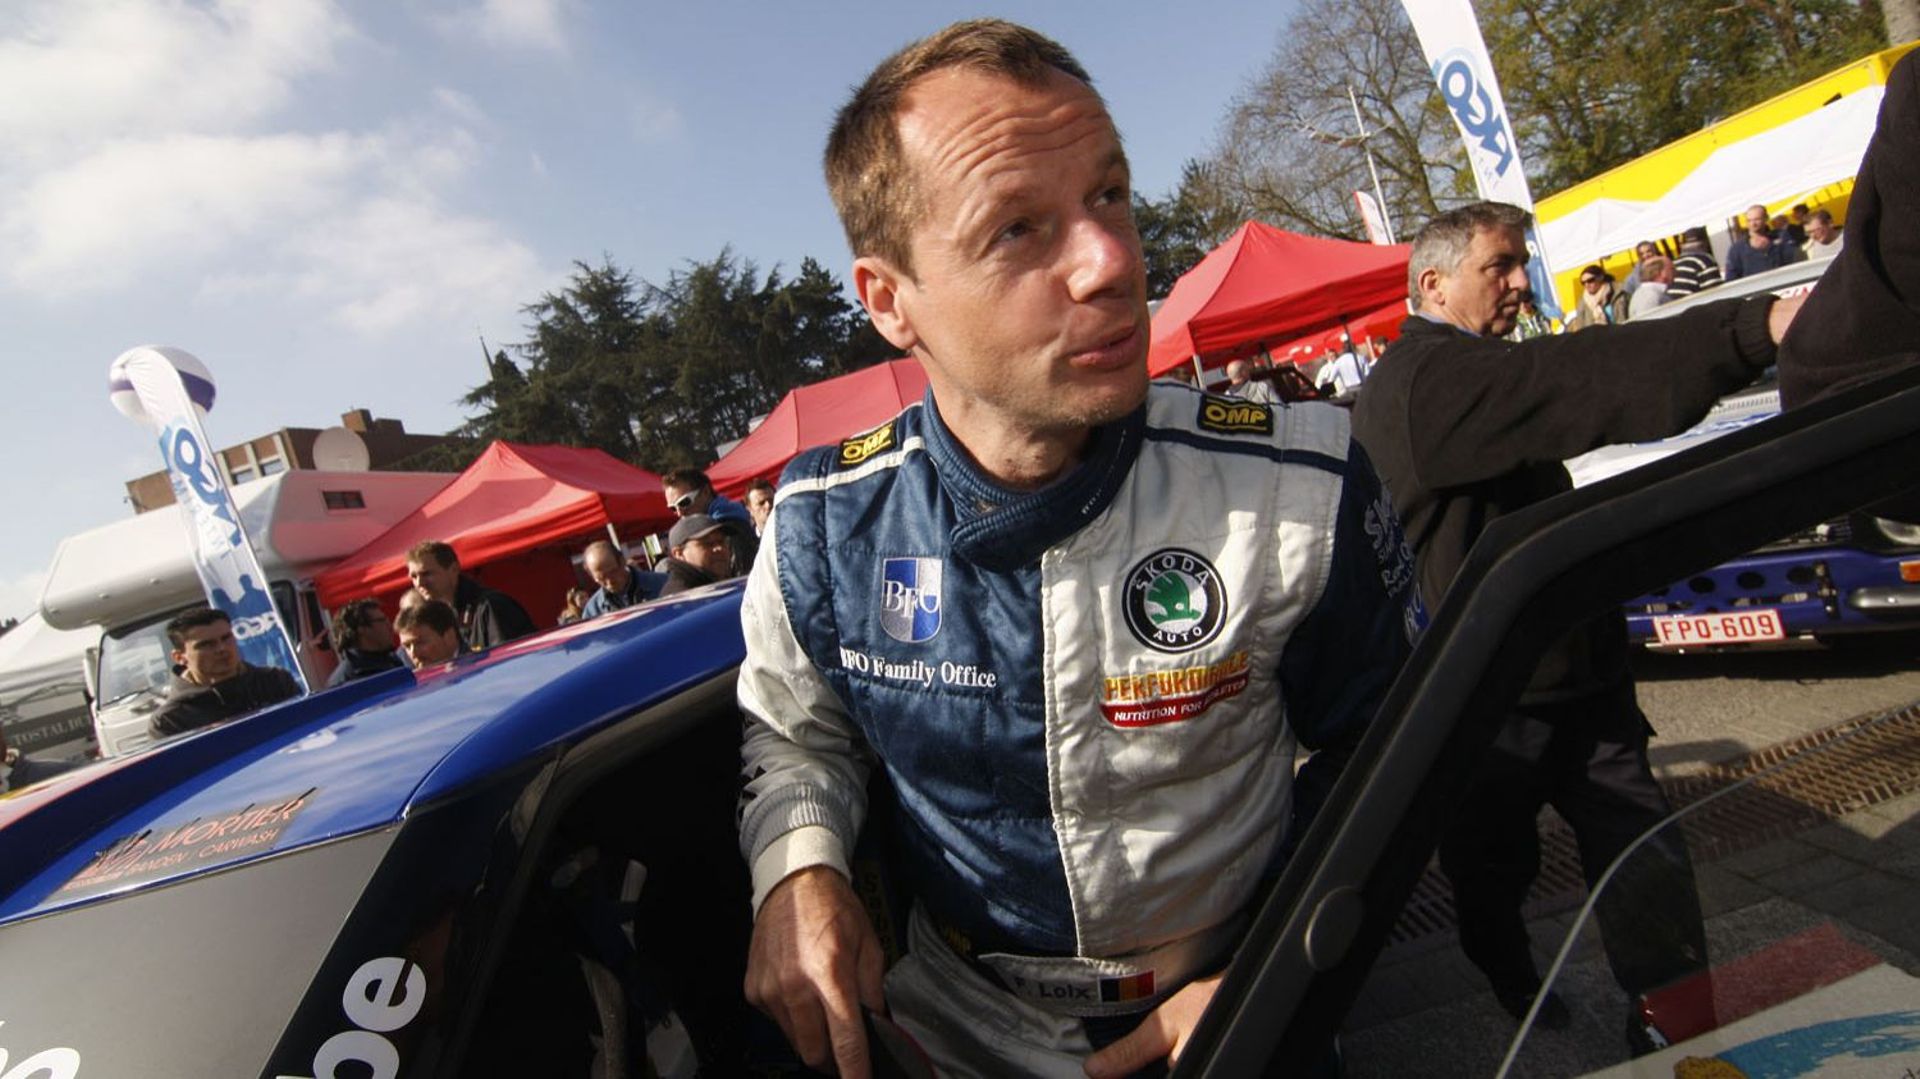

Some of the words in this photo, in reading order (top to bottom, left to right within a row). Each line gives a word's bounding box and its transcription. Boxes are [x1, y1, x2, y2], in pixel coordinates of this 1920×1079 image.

[1205, 404, 1267, 425] OMP
[843, 426, 891, 459] OMP
[1153, 626, 1203, 643] AUTO
[1660, 614, 1776, 640] FPO-609
[873, 657, 936, 688] Family
[941, 661, 997, 689] Office
[1114, 705, 1177, 722] NUTRITION
[1180, 700, 1202, 715] FOR
[1038, 982, 1091, 999] Loix
